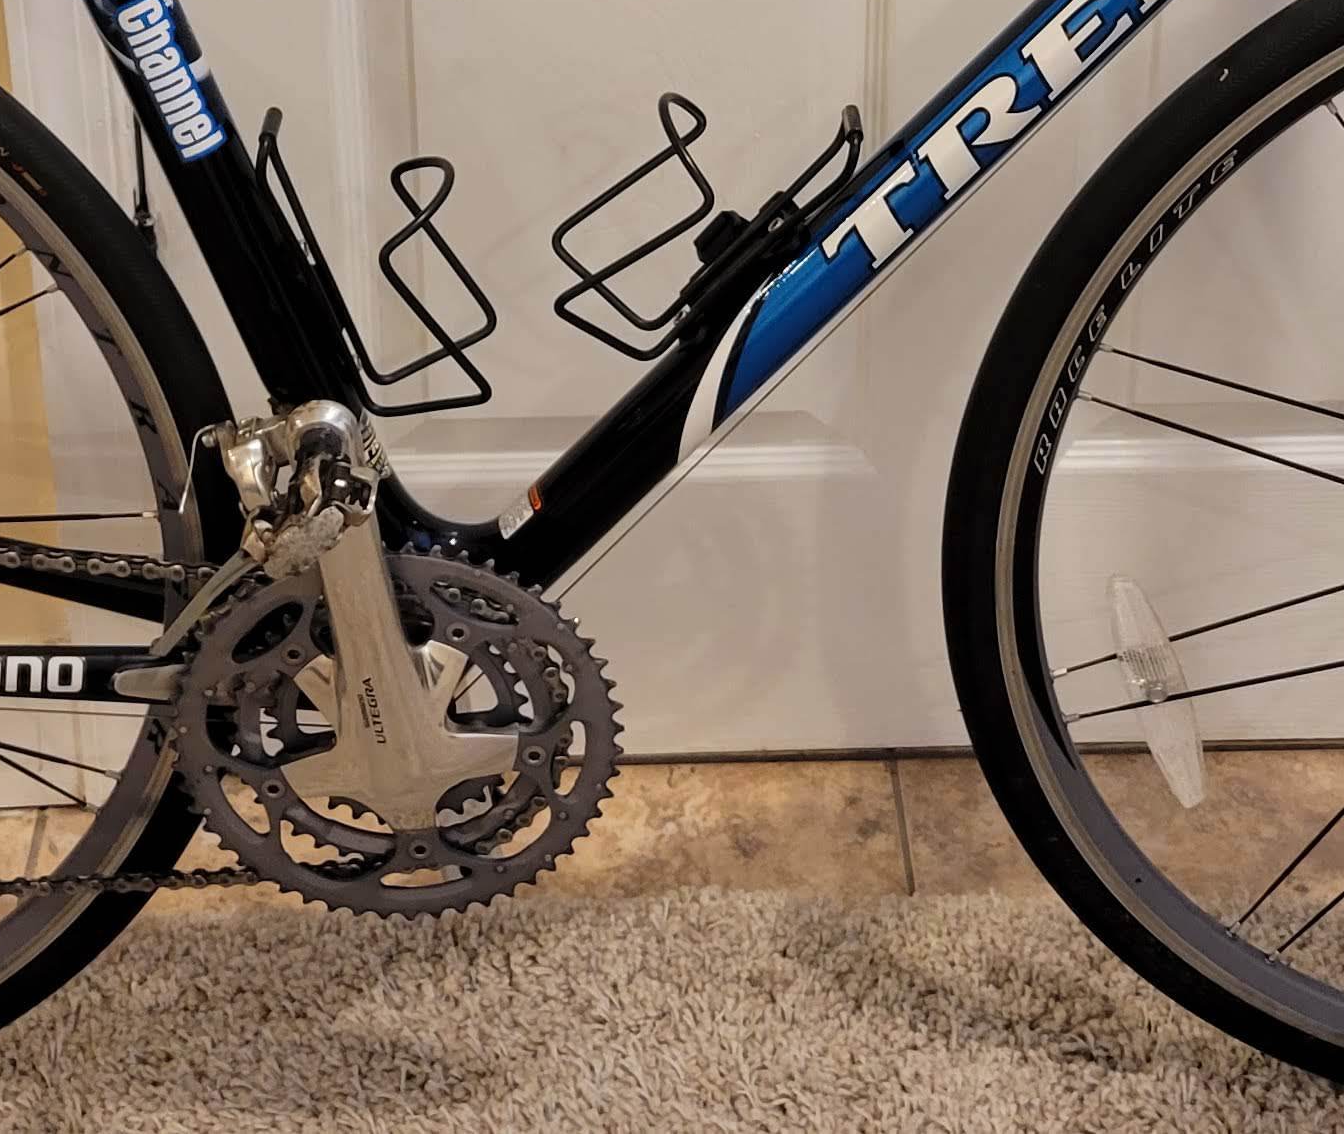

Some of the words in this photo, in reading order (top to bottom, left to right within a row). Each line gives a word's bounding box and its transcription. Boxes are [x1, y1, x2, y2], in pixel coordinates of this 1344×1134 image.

[1034, 304, 1108, 475] RACE
[1120, 149, 1239, 291] LITE
[362, 677, 386, 744] ULTEGRA
